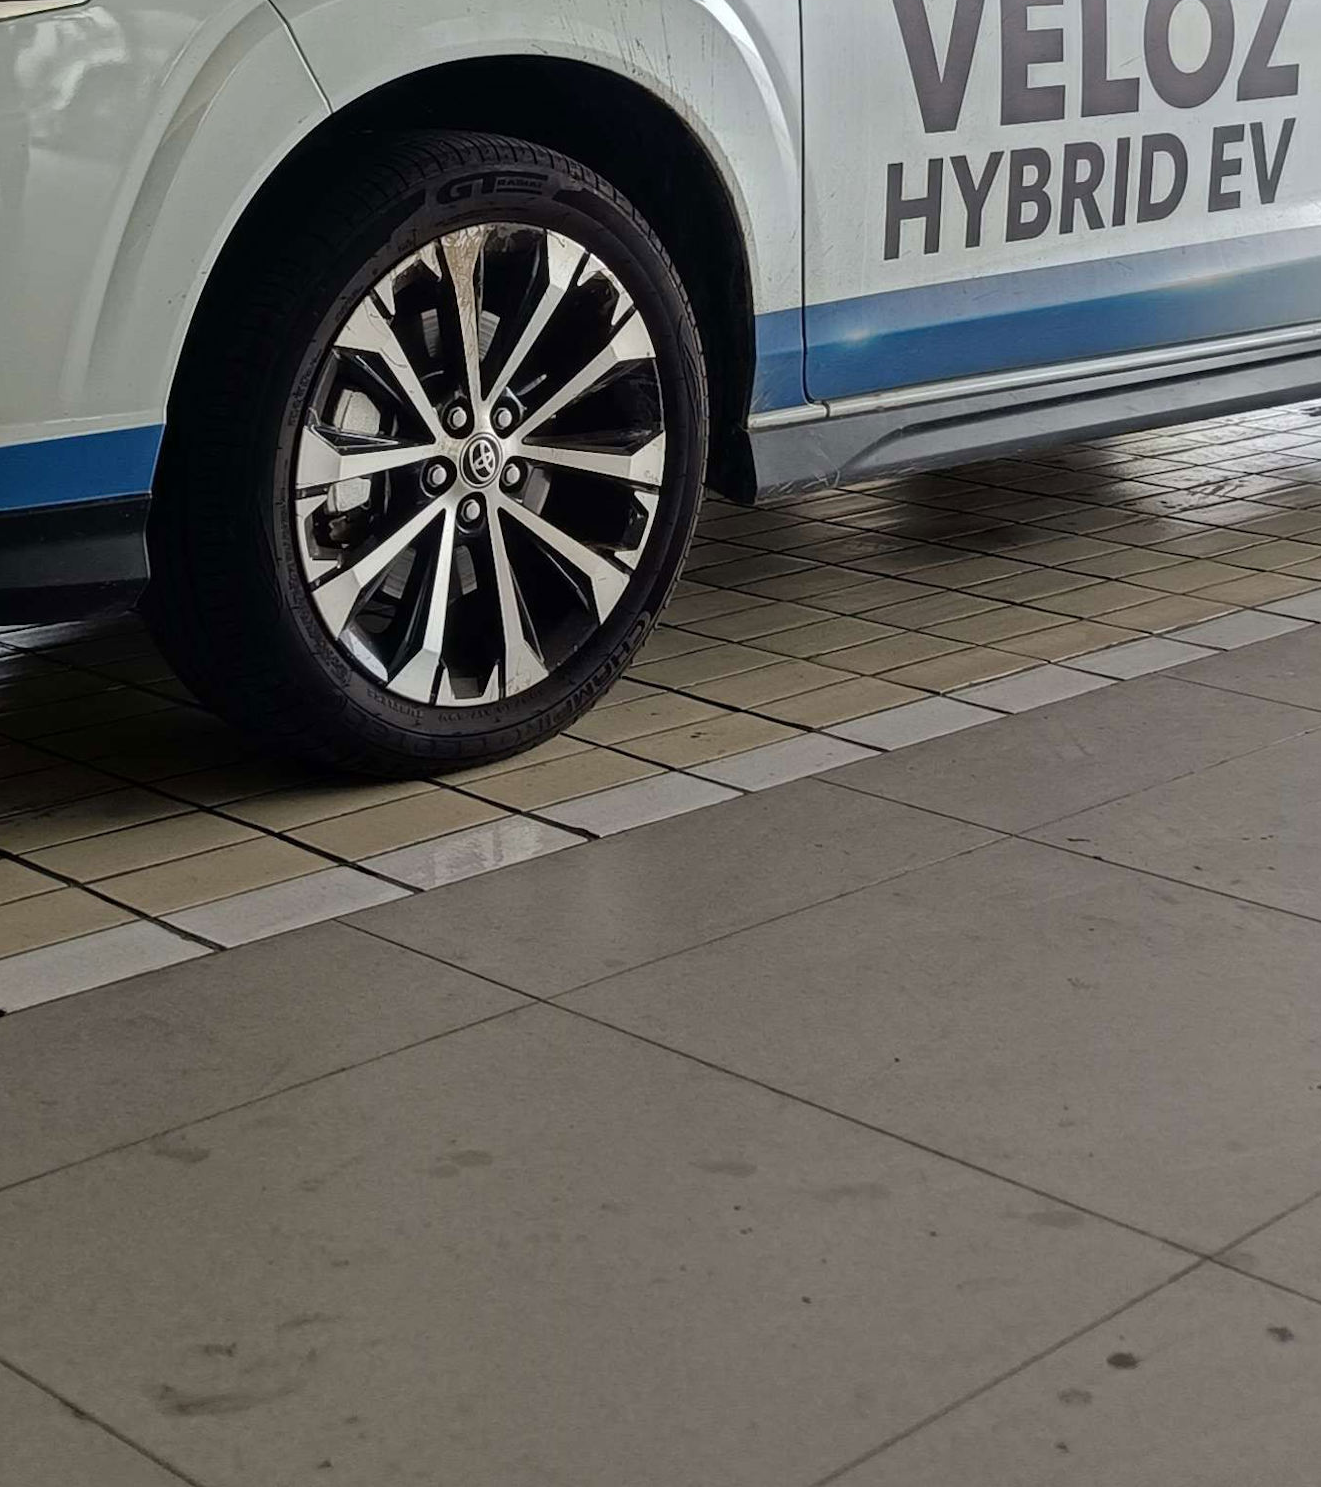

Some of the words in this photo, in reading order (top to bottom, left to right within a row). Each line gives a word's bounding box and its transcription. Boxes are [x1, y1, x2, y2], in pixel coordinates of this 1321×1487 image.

[436, 170, 547, 204] GT
[884, 132, 1188, 260] HYBRID
[1208, 117, 1296, 213] EV
